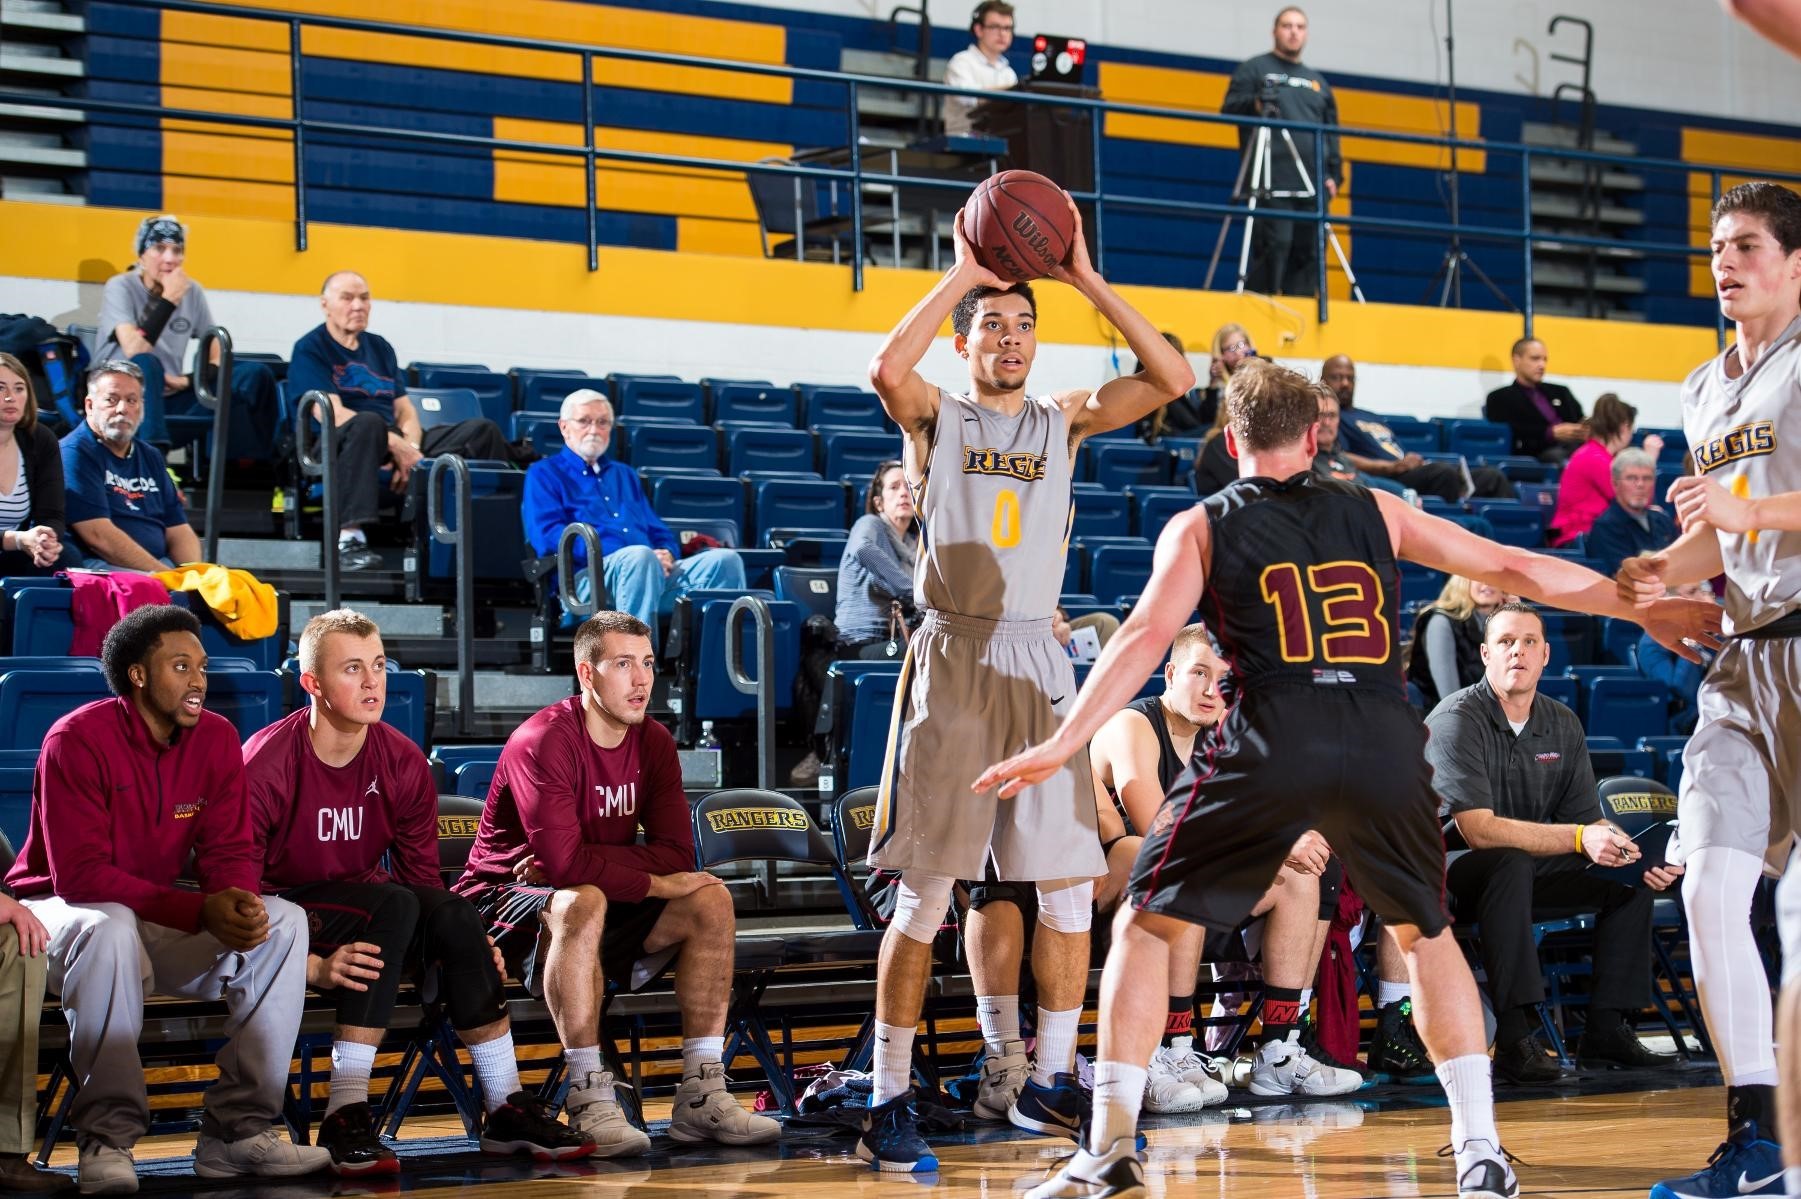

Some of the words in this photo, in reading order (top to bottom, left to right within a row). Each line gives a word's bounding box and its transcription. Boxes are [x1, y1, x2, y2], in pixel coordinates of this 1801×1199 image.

[1012, 210, 1057, 269] Wilson
[991, 489, 1022, 548] 0
[1260, 561, 1390, 665] 13
[318, 806, 363, 842] CMU
[706, 807, 809, 832] RANGERS
